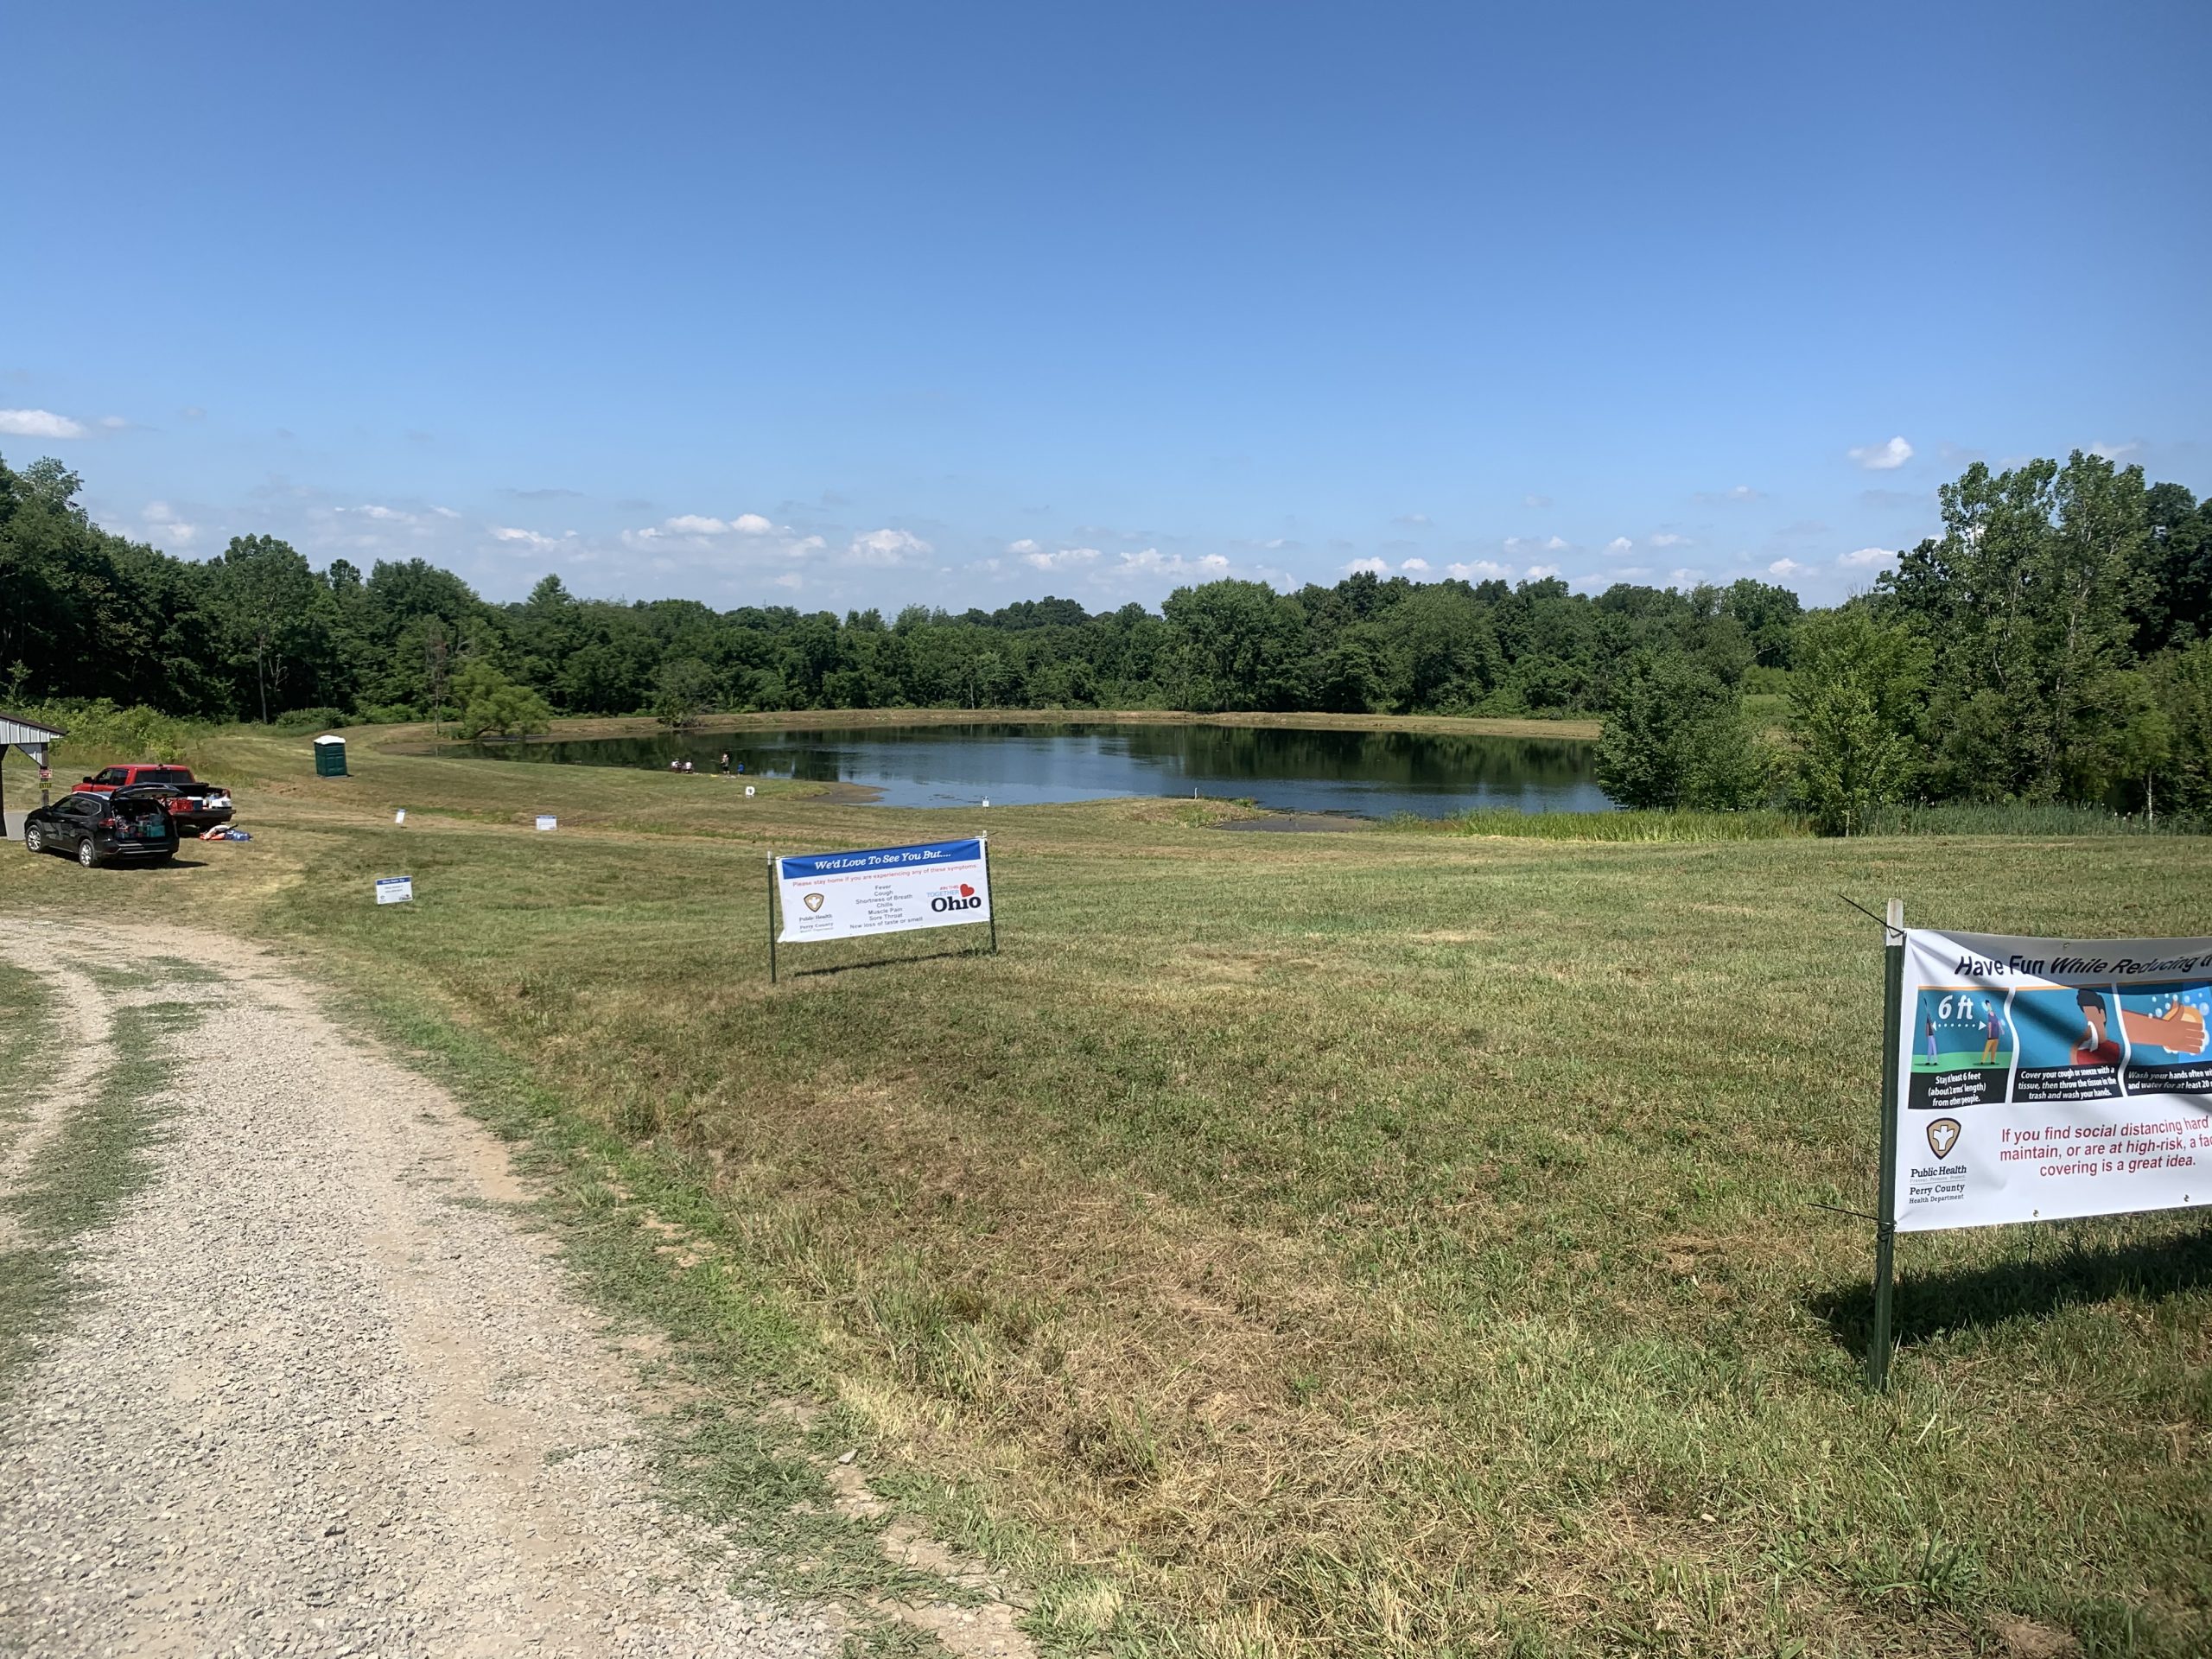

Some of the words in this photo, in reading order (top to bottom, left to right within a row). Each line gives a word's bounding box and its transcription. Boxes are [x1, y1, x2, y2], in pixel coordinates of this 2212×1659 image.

[815, 861, 840, 870] We'd
[842, 859, 866, 868] Love
[868, 855, 881, 864] To
[882, 855, 900, 863] See
[902, 852, 921, 861] You
[923, 850, 951, 859] But....
[931, 896, 982, 912] Ohio
[1955, 956, 2004, 976] Have
[2010, 956, 2044, 975] Fun
[2050, 957, 2108, 974] While
[2109, 956, 2200, 974] Reducing
[1939, 995, 1953, 1020] 6
[1957, 995, 1974, 1020] ft
[1936, 1075, 1947, 1085] Stay
[1951, 1073, 1962, 1082] least
[1963, 1072, 1967, 1081] 6
[1968, 1071, 1981, 1080] feet
[2043, 1071, 2056, 1080] your
[2057, 1068, 2074, 1078] cough
[2097, 1065, 2109, 1074] with
[1929, 1087, 1949, 1096] (about
[1964, 1082, 1986, 1093] length)
[2081, 1091, 2093, 1100] your
[2094, 1088, 2112, 1096] hands.
[1932, 1097, 1948, 1106] from
[1949, 1096, 1961, 1105] other
[1961, 1094, 1980, 1106] people.
[2002, 1128, 2011, 1142] If
[2014, 1130, 2040, 1145] you
[2045, 1126, 2071, 1140] find
[2075, 1124, 2117, 1138] social
[2120, 1120, 2183, 1135] distancing
[2183, 1116, 2209, 1130] hard
[2000, 1145, 2062, 1161] maintain,
[2067, 1146, 2081, 1156] or
[2084, 1144, 2105, 1155] are
[2109, 1141, 2122, 1154] at
[2126, 1136, 2186, 1155] high-risk,
[2190, 1138, 2196, 1147] a
[1910, 1167, 1938, 1177] Public
[1938, 1165, 1967, 1175] Health
[2040, 1160, 2097, 1176] covering
[2102, 1159, 2112, 1172] is
[2117, 1160, 2124, 1171] a
[2128, 1156, 2162, 1173] great
[2165, 1154, 2196, 1167] idea.
[1910, 1187, 1933, 1196] Perry
[1936, 1184, 1965, 1192] County
[1930, 1194, 1964, 1203] Department
